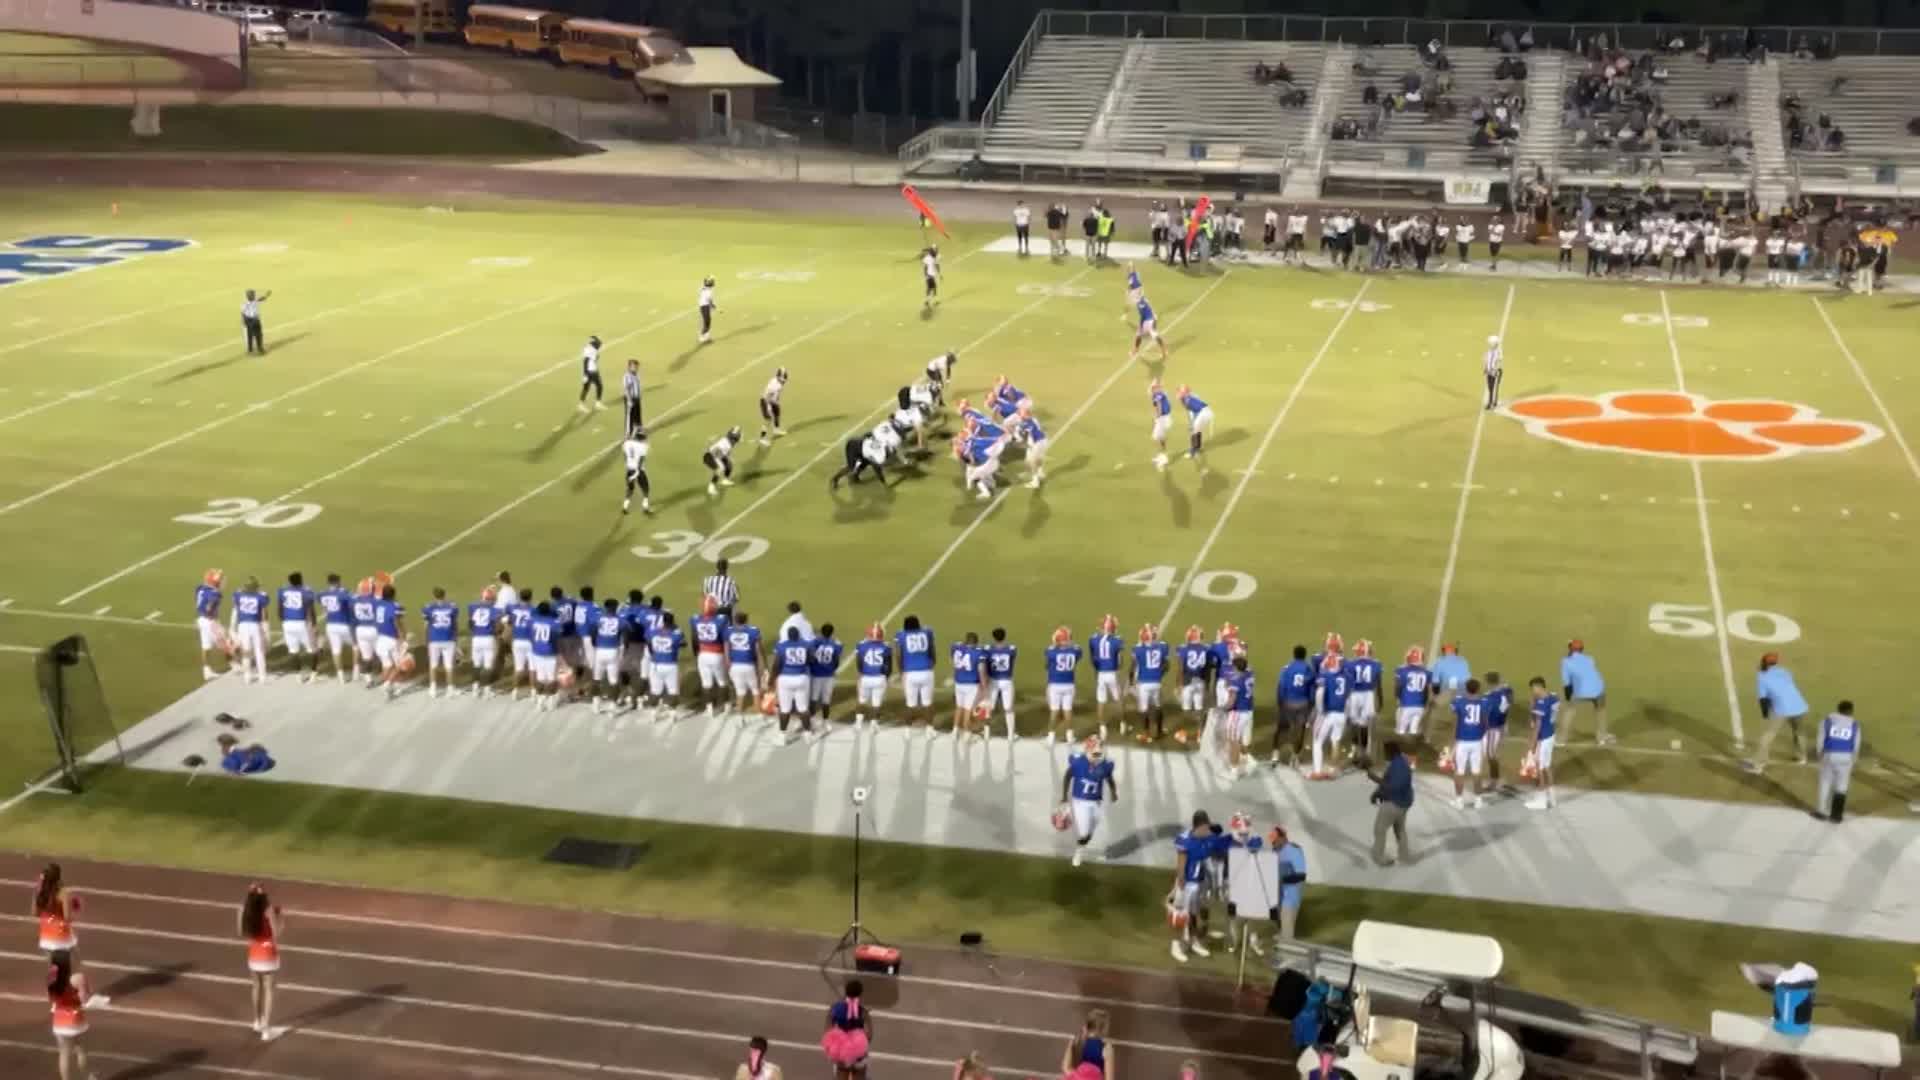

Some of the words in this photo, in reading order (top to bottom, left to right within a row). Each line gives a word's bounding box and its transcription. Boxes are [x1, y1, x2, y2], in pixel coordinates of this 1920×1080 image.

[171, 498, 323, 528] 20
[630, 529, 772, 564] 30
[1115, 565, 1258, 602] 40
[532, 621, 551, 643] 70
[1648, 602, 1801, 644] 50
[905, 632, 929, 654] 60
[863, 648, 884, 667] 45
[1055, 652, 1076, 672] 50
[1145, 650, 1161, 669] 12
[1354, 664, 1373, 684] 14
[1406, 671, 1427, 693] 30
[1334, 677, 1346, 696] 3
[1464, 703, 1481, 725] 31
